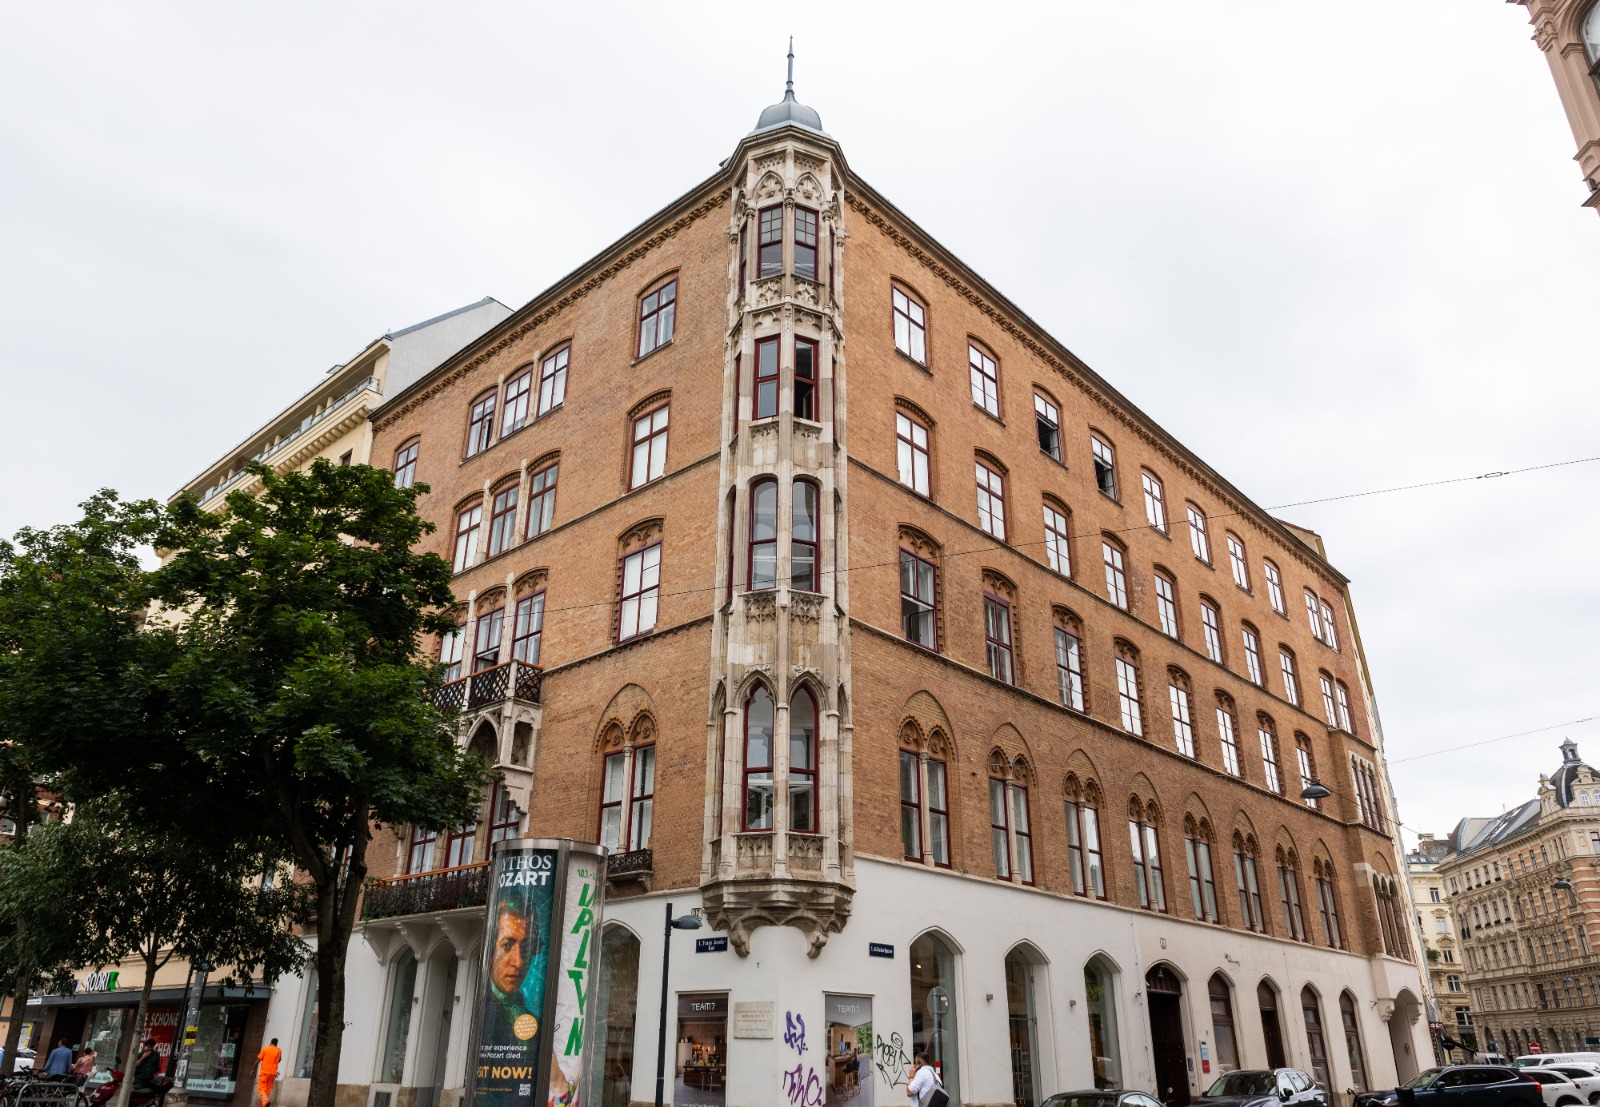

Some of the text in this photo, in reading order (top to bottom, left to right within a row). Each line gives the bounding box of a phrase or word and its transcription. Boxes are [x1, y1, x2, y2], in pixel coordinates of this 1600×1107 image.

[502, 855, 552, 871] YTHOS
[497, 870, 551, 888] OZART
[493, 1044, 528, 1052] experience
[491, 1066, 533, 1079] NOW!
